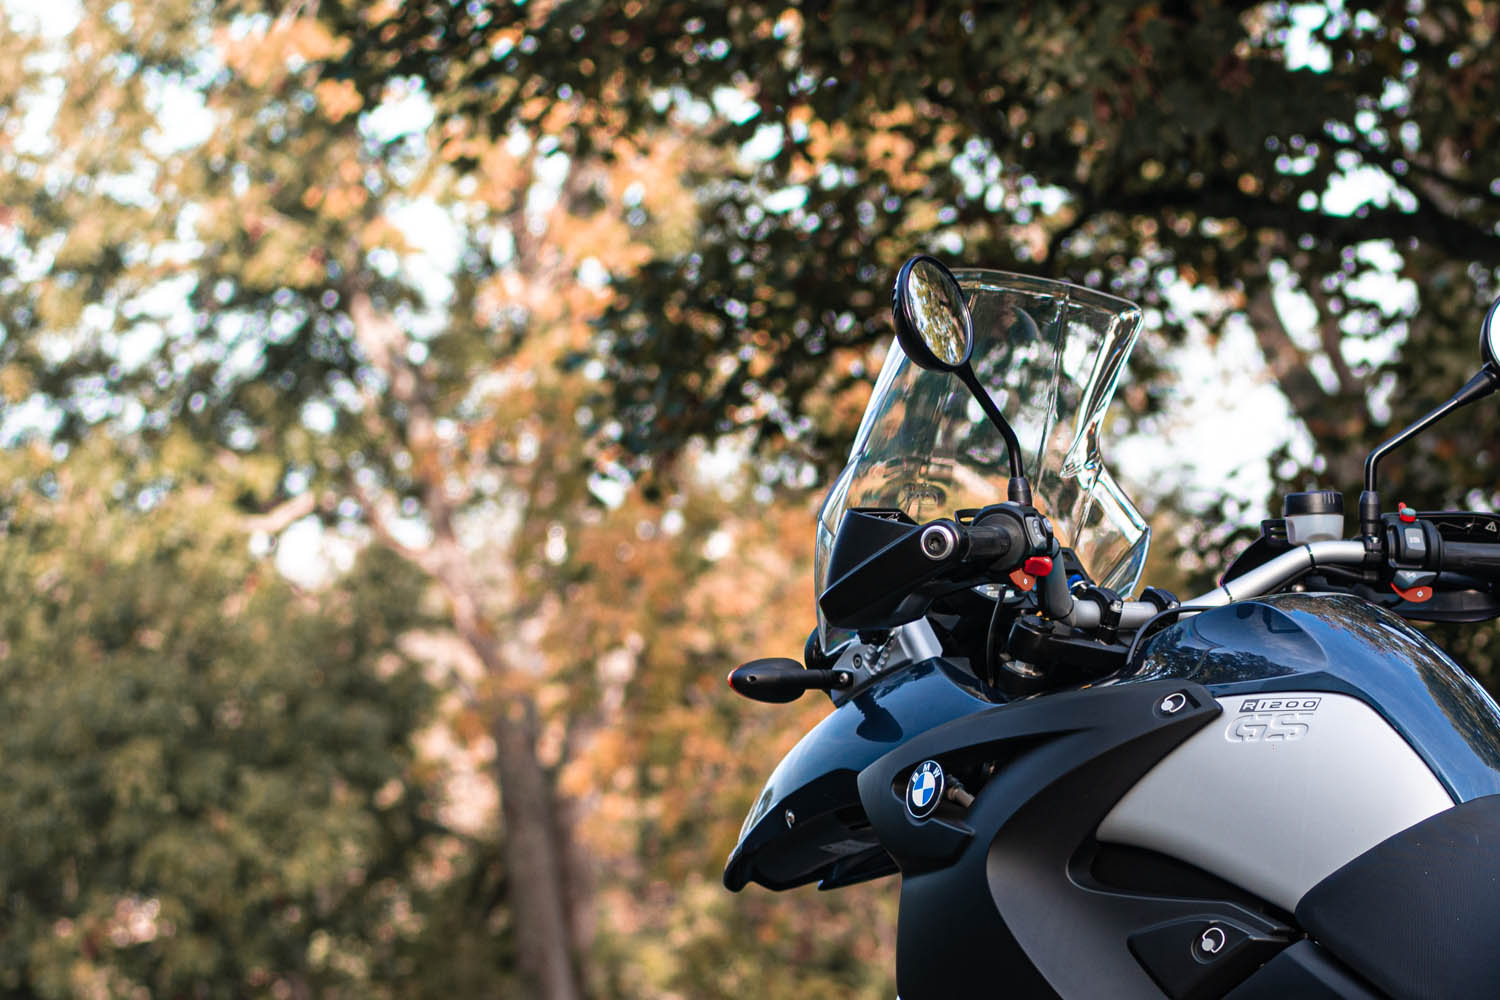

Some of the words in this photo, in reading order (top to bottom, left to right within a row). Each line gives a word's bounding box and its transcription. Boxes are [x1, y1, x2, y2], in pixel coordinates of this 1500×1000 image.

[1241, 698, 1320, 712] R1200
[1224, 713, 1315, 743] GS
[912, 763, 941, 783] BMW
